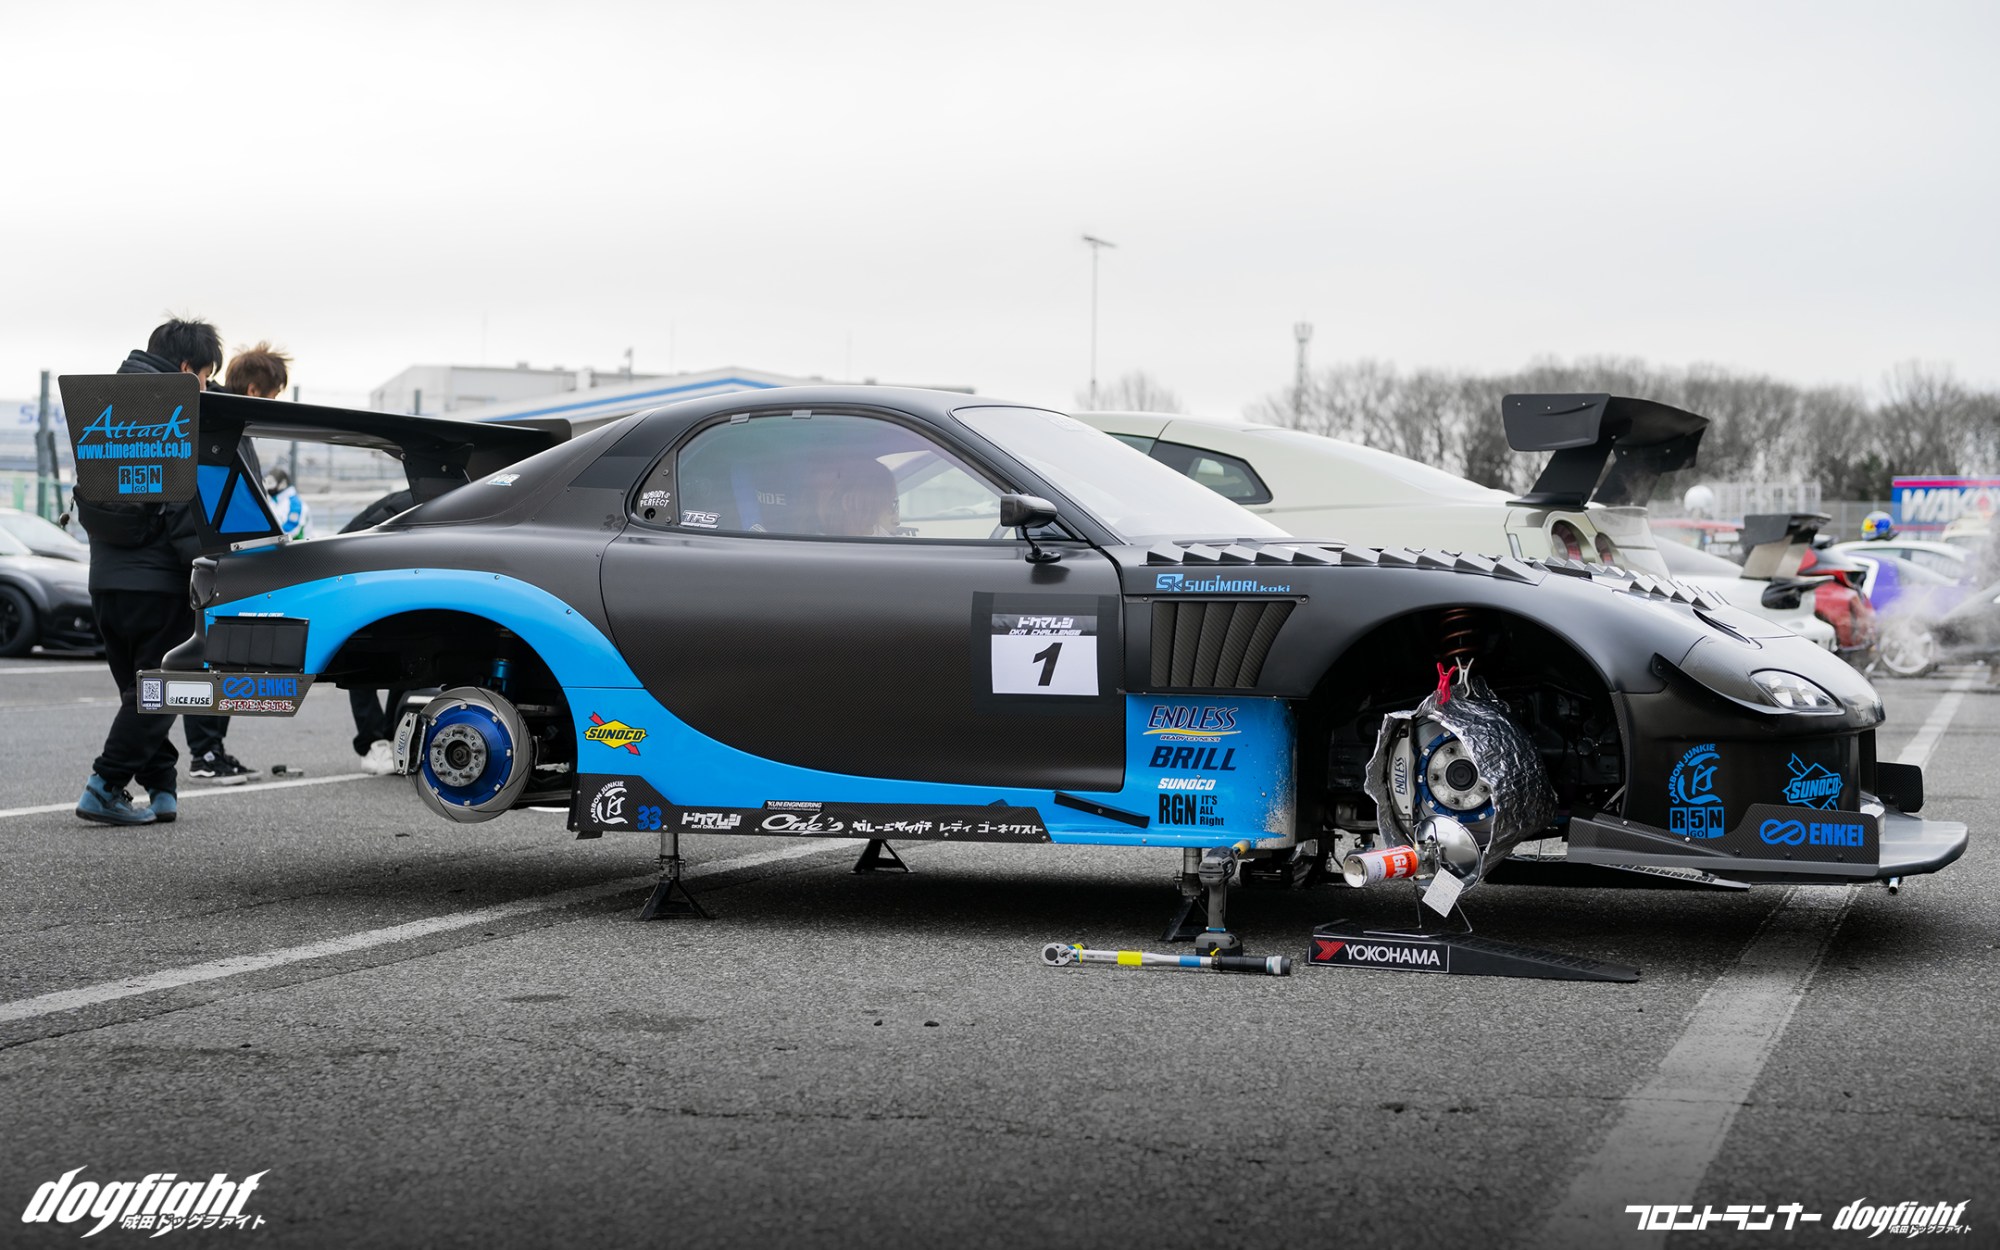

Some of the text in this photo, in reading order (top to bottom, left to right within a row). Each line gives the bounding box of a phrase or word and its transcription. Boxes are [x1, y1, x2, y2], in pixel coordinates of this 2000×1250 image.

[78, 404, 190, 444] Attack
[77, 440, 192, 460] www.timeattack.co.jp
[640, 499, 669, 508] PERFECT
[683, 510, 720, 524] TRS
[1032, 642, 1063, 687] 1
[257, 678, 297, 697] ENKEI
[189, 697, 210, 705] FUSE
[1147, 704, 1239, 730] ENDLESS
[587, 728, 643, 741] SUNOCO
[1149, 746, 1237, 771] BRILL
[1395, 756, 1406, 795] ENDLESS
[1668, 743, 1716, 803] CARBON JUNKIE
[601, 780, 624, 794] JUNKIE
[1157, 777, 1217, 791] SUNOCO
[1790, 776, 1839, 799] SUNOCO
[1158, 793, 1197, 825] RGN
[1201, 795, 1218, 805] IT'S
[1200, 806, 1214, 815] ALL
[977, 820, 1044, 835] ゴーネクスト
[1200, 816, 1224, 826] Right
[1809, 823, 1864, 846] ENKEI
[1391, 853, 1407, 879] GA
[1345, 944, 1441, 966] YOKOHAMA
